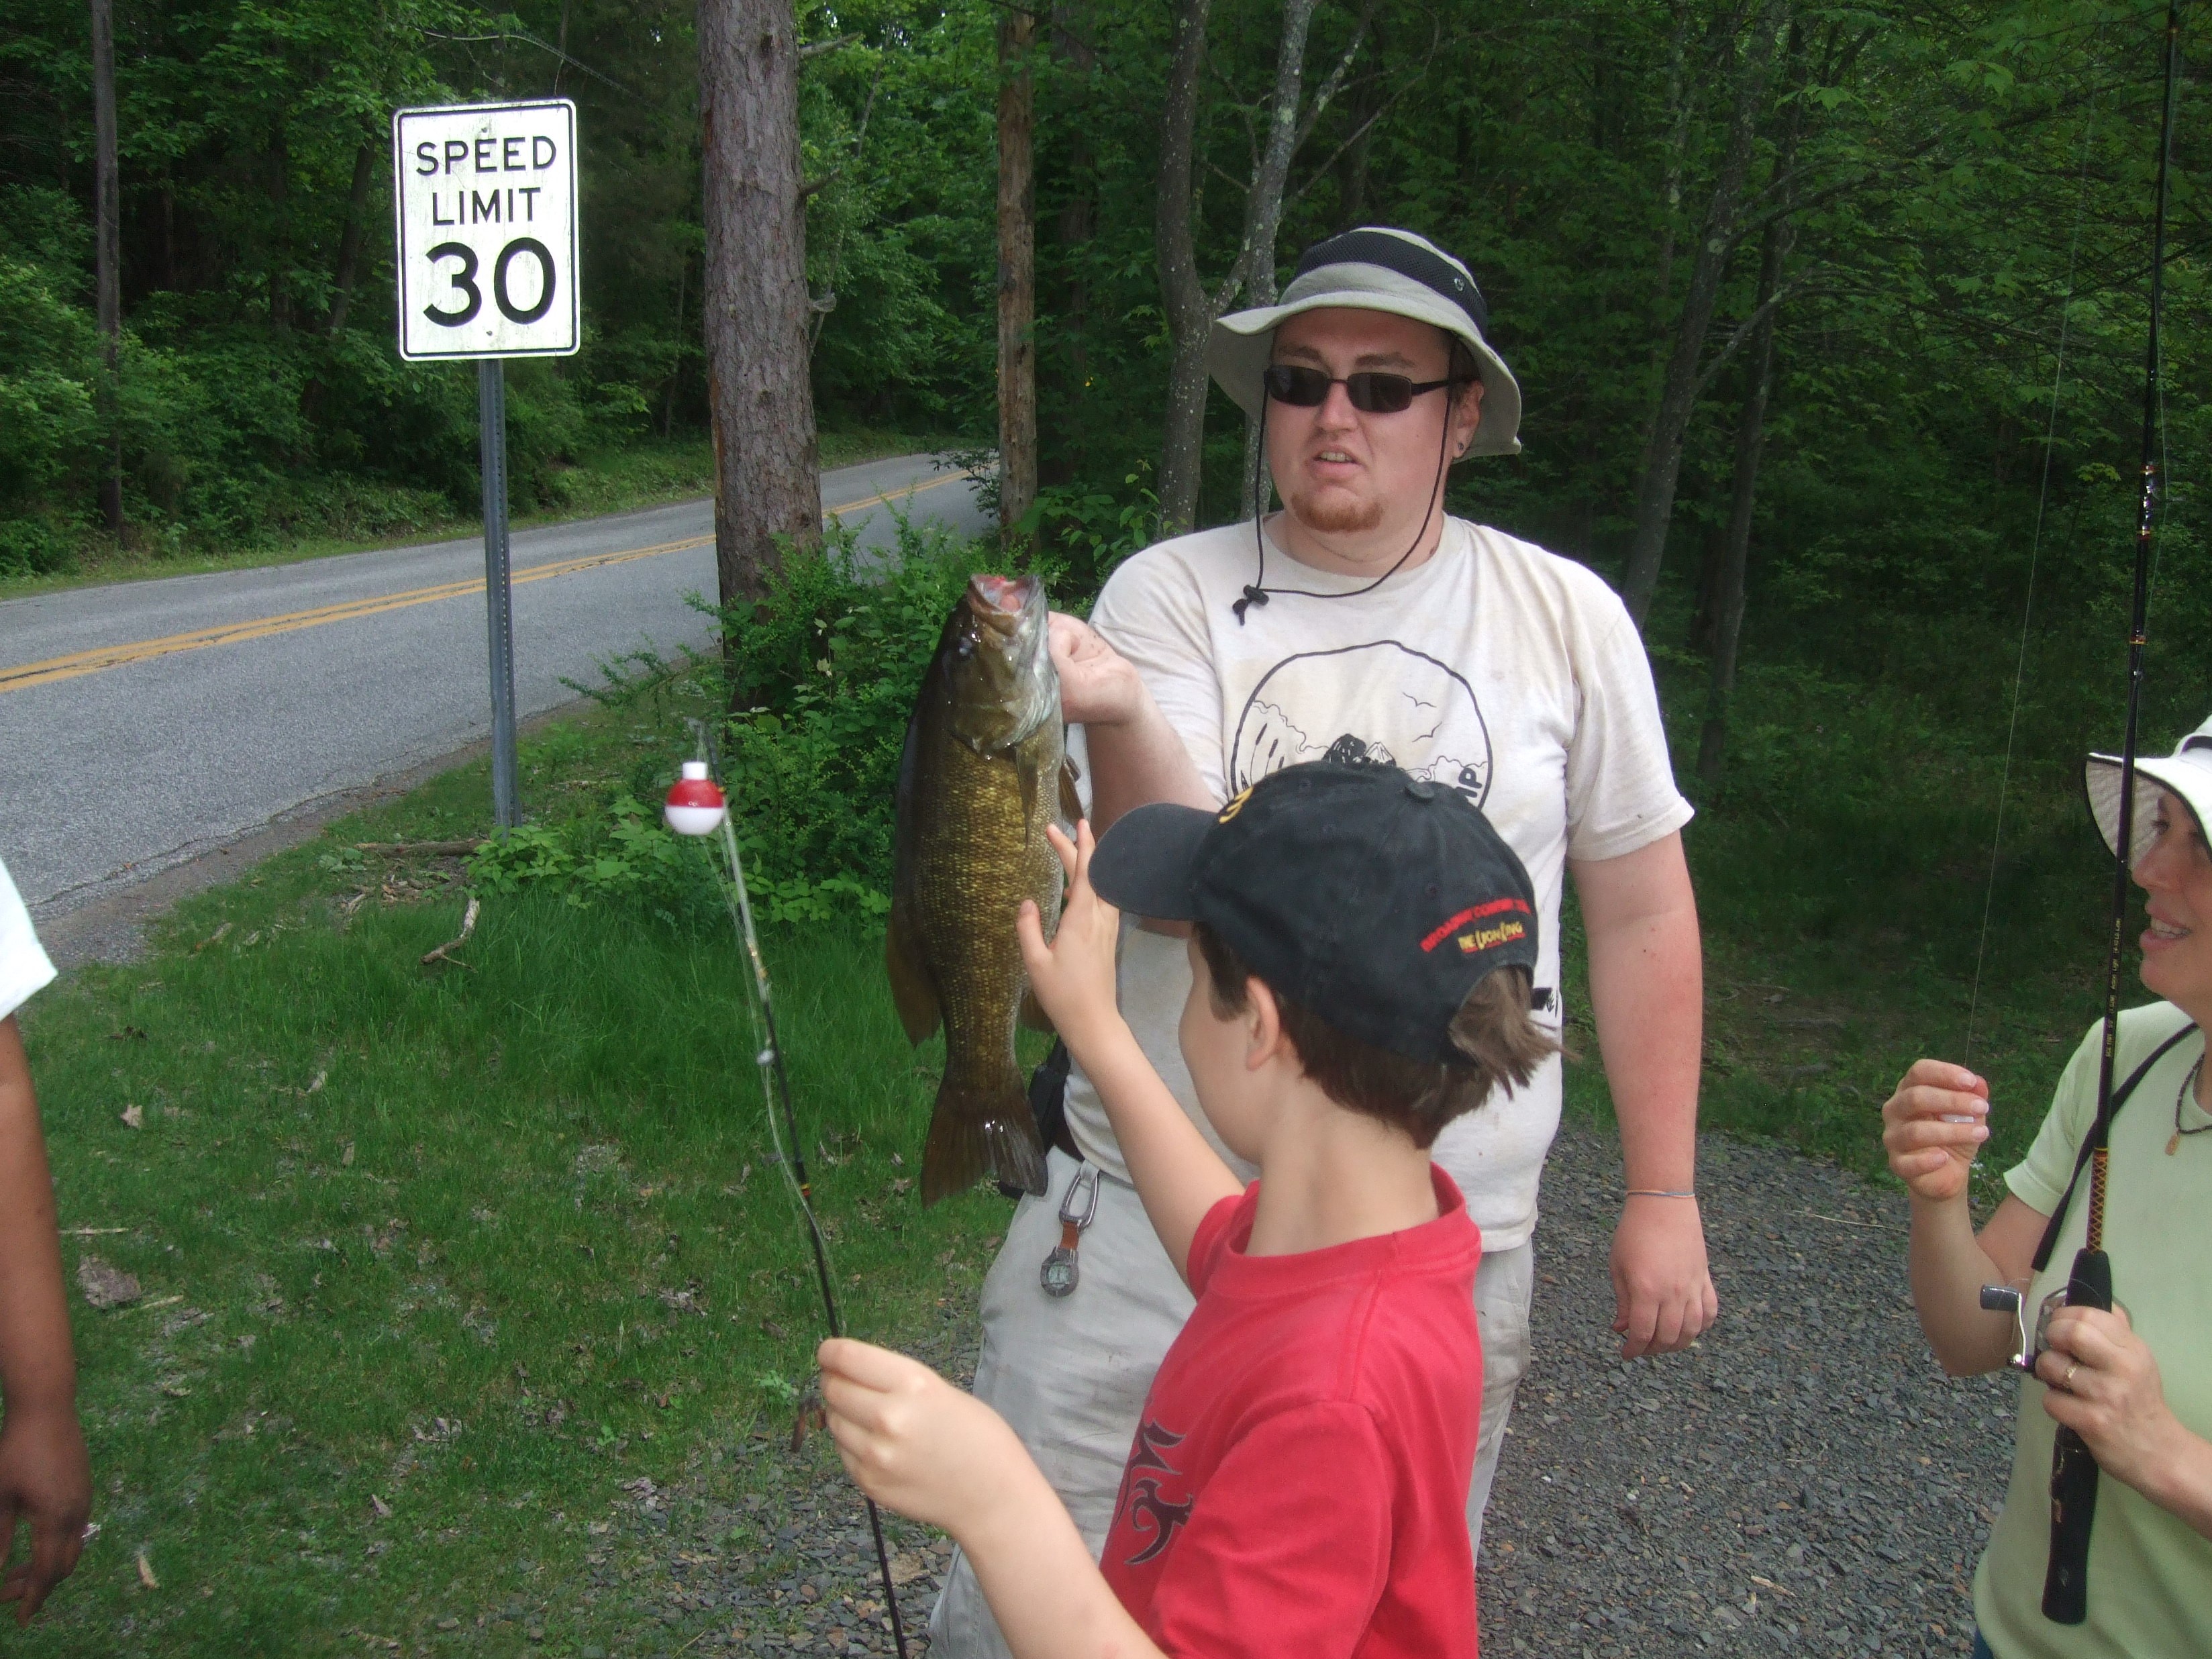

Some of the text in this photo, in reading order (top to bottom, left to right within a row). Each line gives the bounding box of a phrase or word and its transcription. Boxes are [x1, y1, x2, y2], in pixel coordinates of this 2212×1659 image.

[416, 136, 556, 176] SPEED
[432, 187, 541, 225] LIMIT
[423, 237, 556, 328] 30
[1475, 929, 1501, 950] LION
